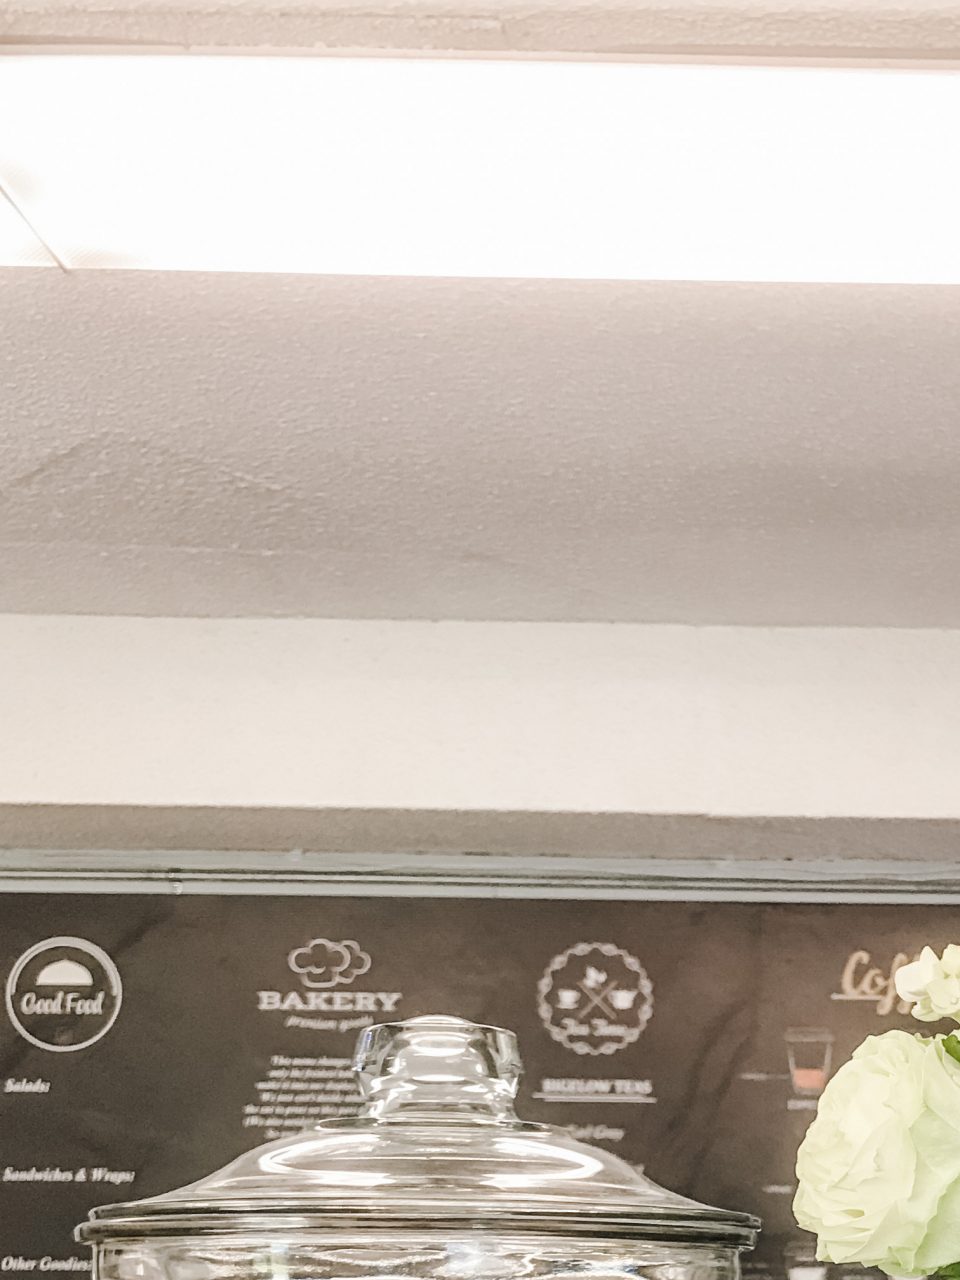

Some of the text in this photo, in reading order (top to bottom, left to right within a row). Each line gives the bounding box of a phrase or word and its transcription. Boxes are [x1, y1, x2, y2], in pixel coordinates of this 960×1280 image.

[841, 950, 920, 1015] Cof
[21, 991, 105, 1015] Good Food
[257, 991, 402, 1011] BAKERY
[3, 1166, 74, 1182] Sandwiches
[75, 1167, 87, 1182] &
[1, 1256, 37, 1271] Other
